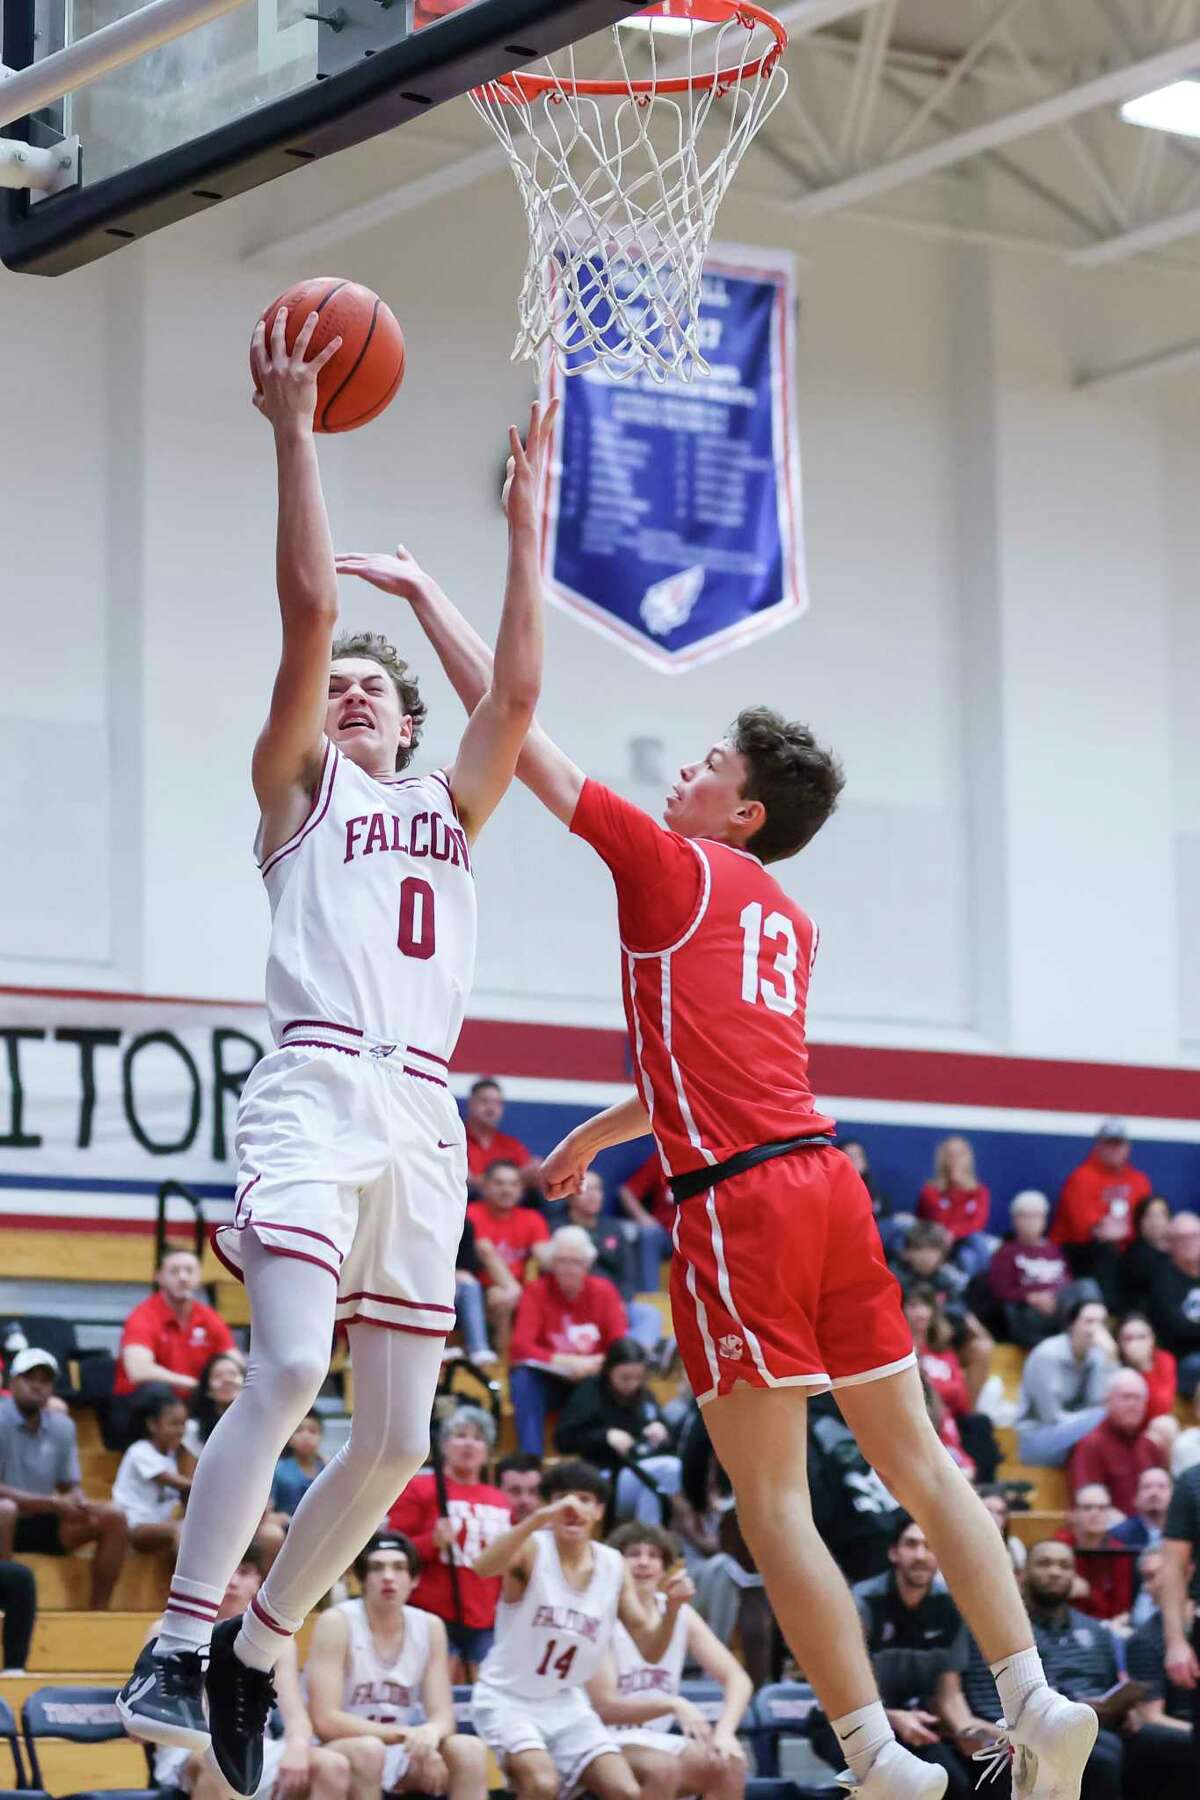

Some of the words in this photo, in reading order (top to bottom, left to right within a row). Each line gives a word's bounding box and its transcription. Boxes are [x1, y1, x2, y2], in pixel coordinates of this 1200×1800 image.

[397, 876, 436, 960] 0
[739, 901, 798, 1017] 13
[536, 1639, 578, 1680] 14
